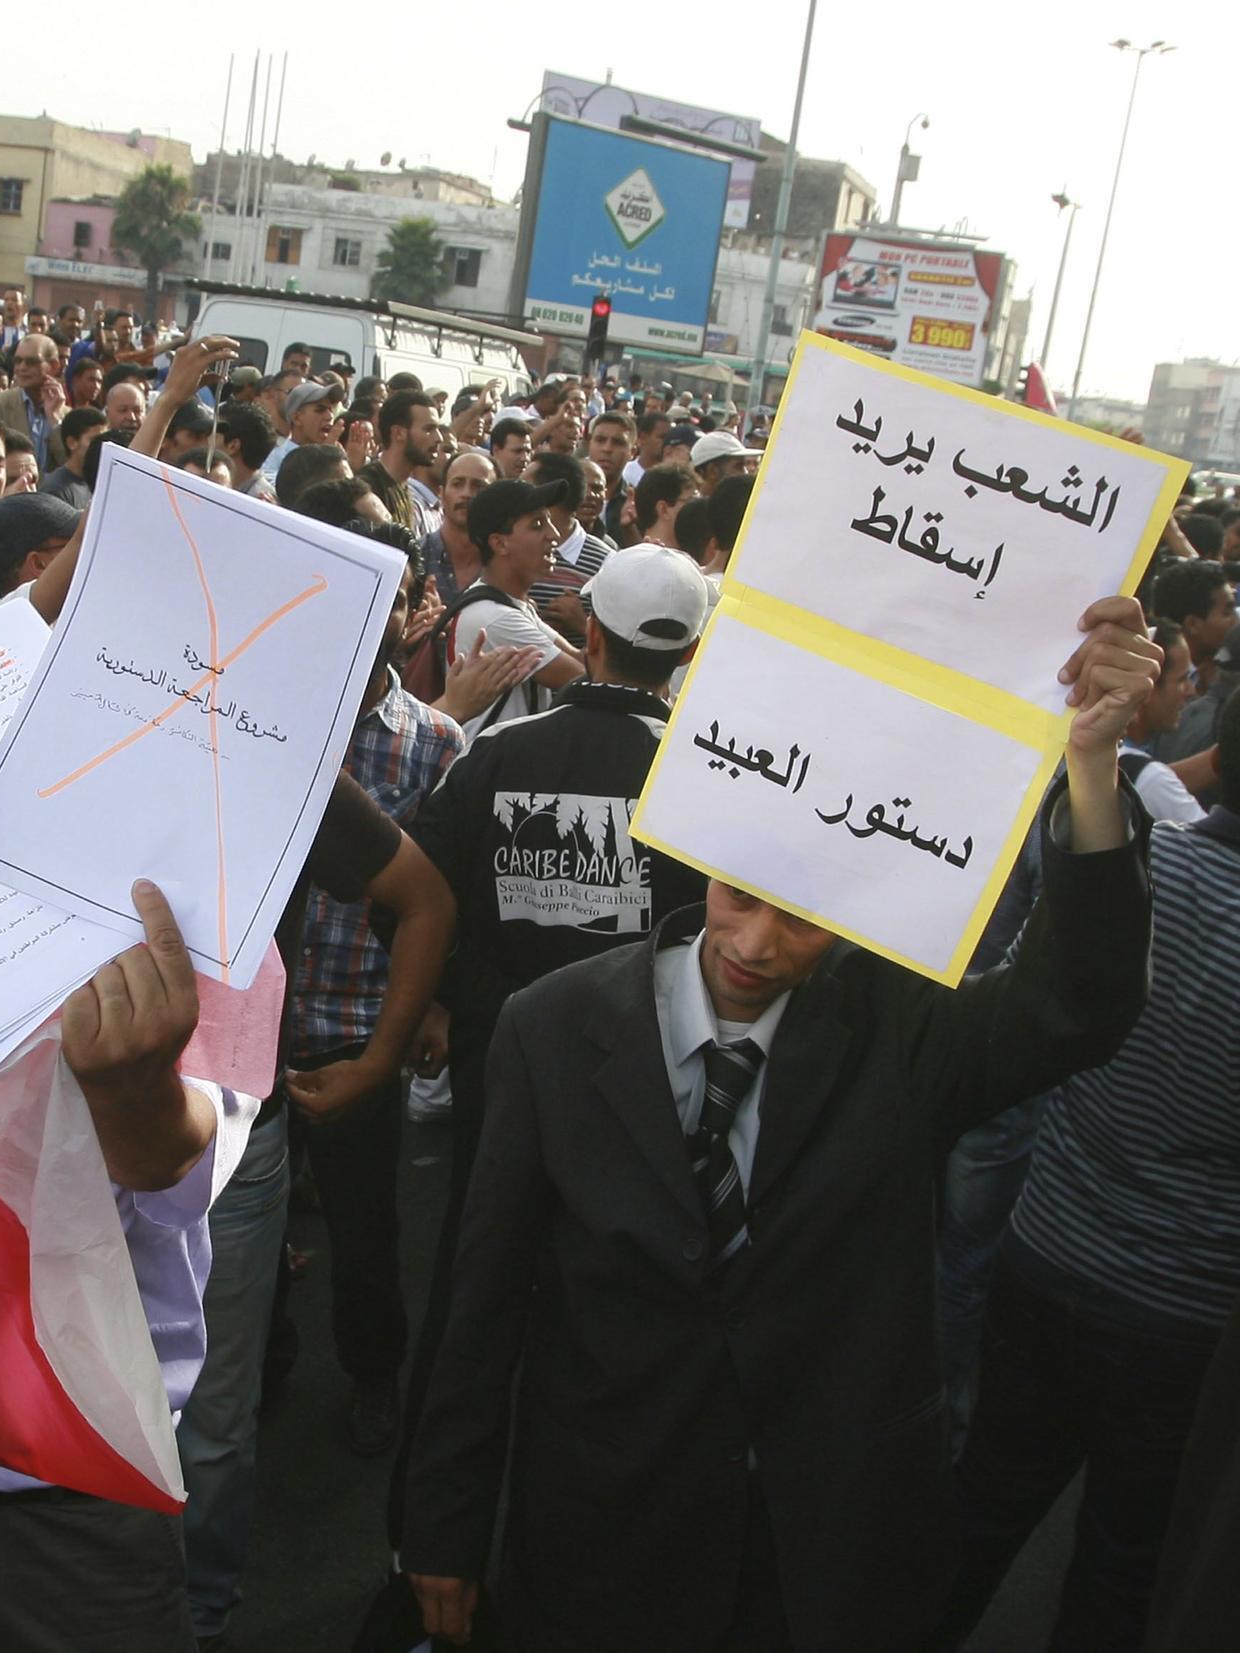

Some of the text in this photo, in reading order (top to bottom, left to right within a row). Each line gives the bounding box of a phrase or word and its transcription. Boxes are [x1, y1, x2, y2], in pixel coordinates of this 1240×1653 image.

[617, 201, 652, 223] ACRED
[837, 400, 1119, 532] الشعب يريد
[852, 487, 1003, 599] إسقاط
[96, 647, 167, 688] الدستورية
[166, 678, 237, 720] المراجعة
[235, 710, 288, 743] مشروع
[694, 721, 972, 868] دستور العبيد
[540, 885, 553, 898] di
[584, 889, 647, 905] Caraibici
